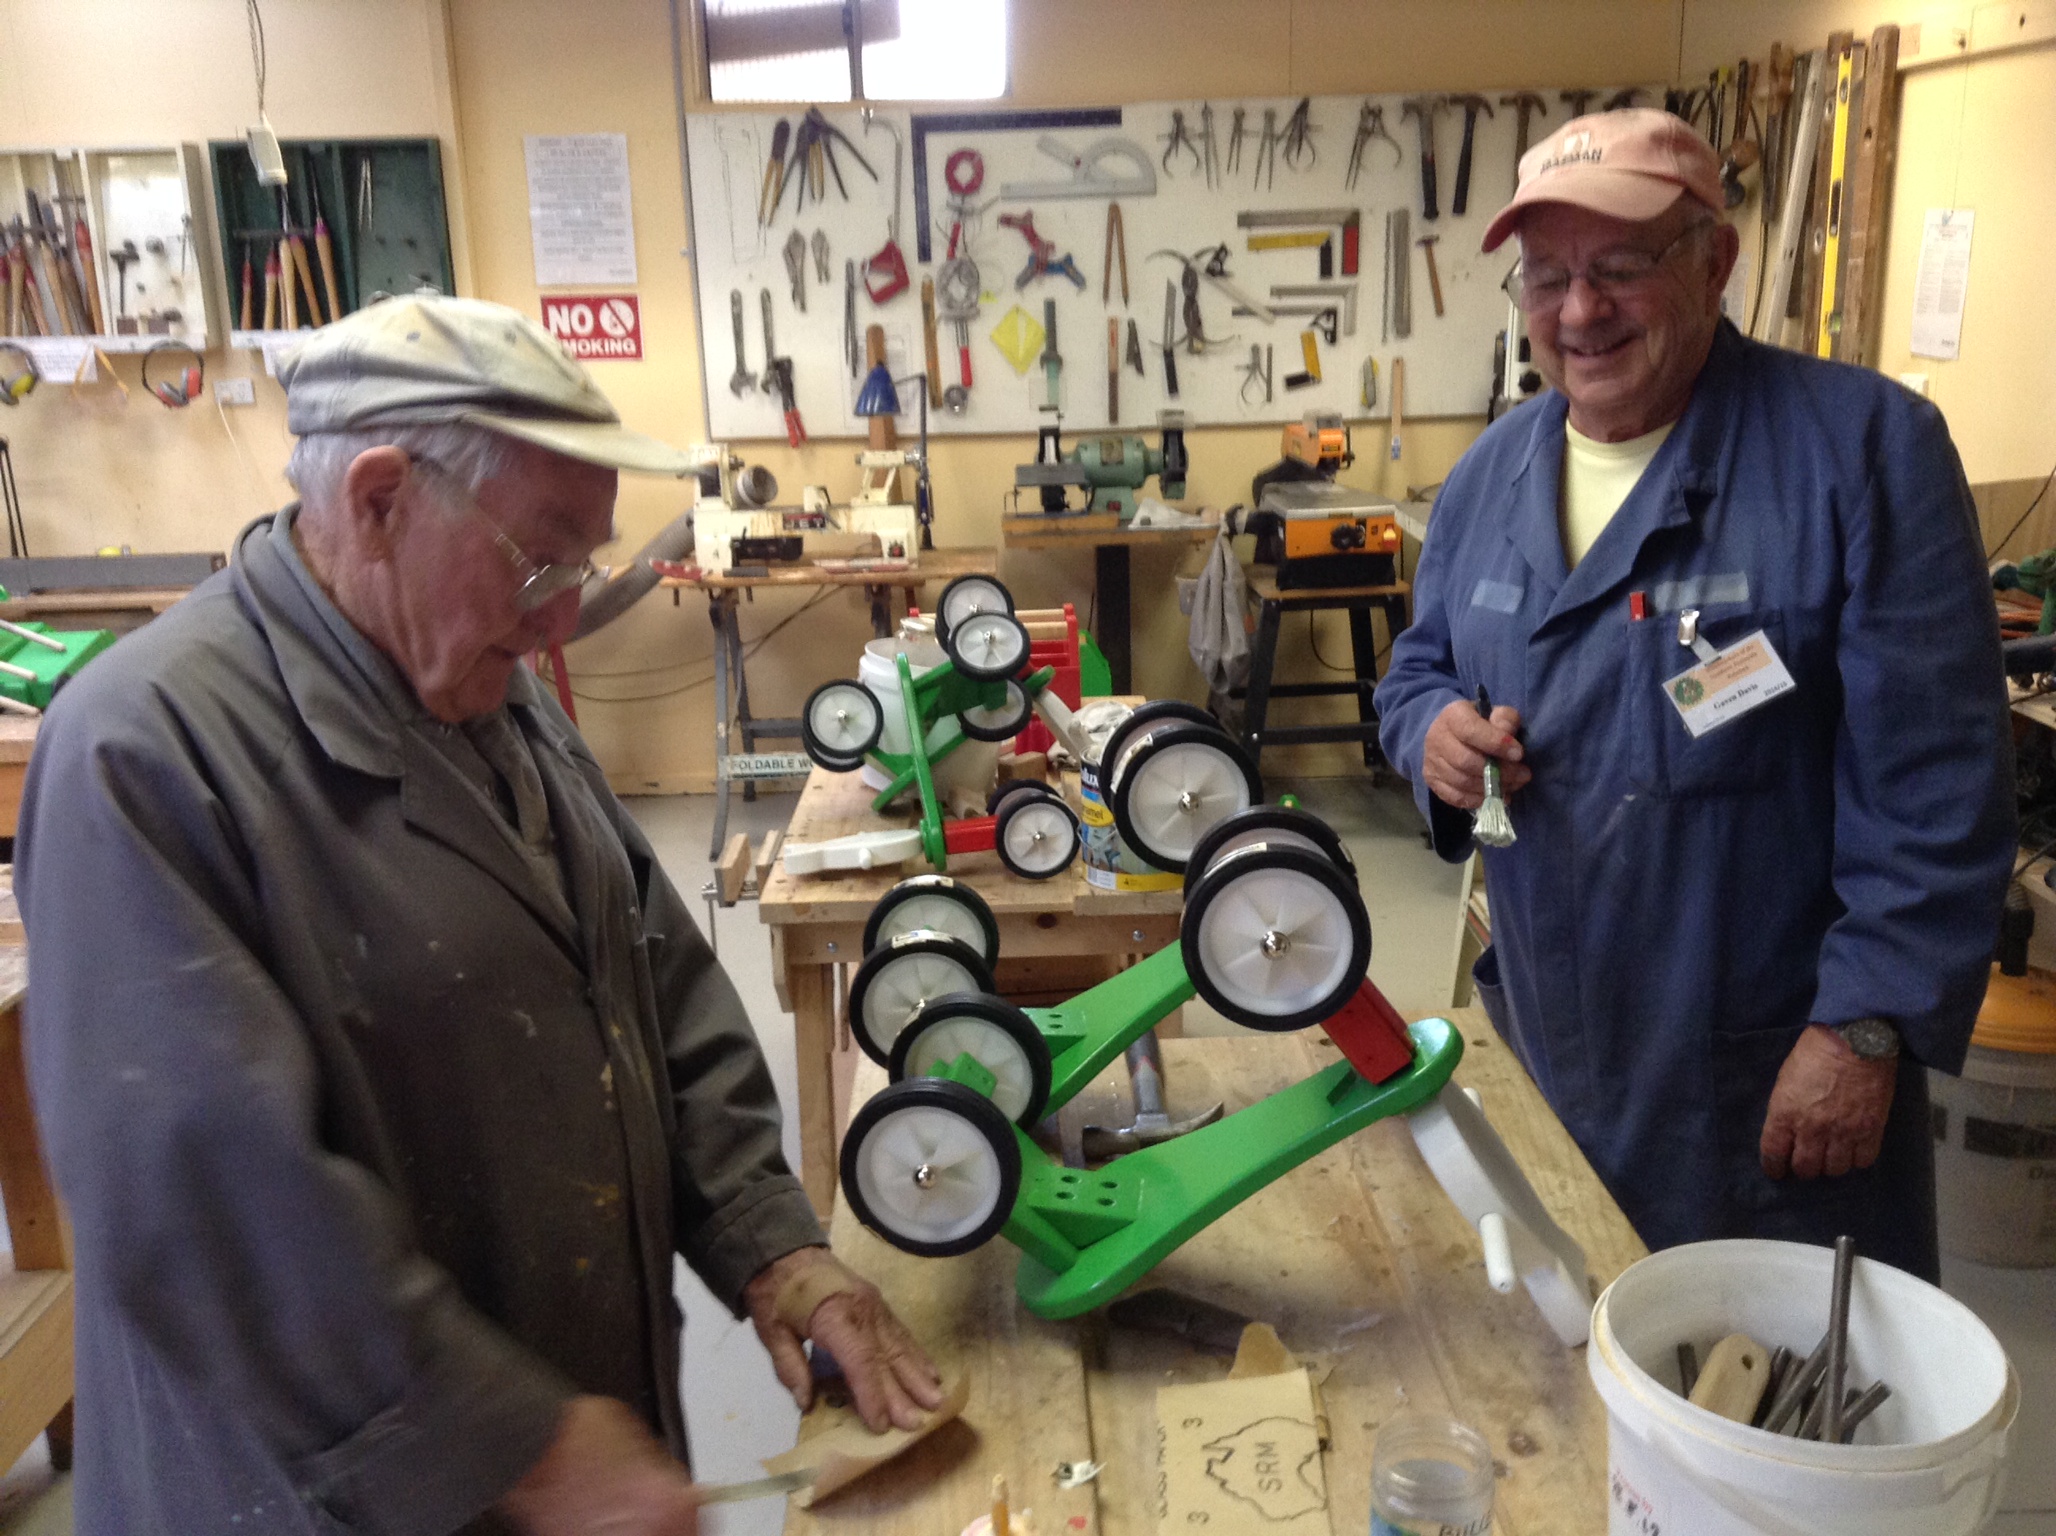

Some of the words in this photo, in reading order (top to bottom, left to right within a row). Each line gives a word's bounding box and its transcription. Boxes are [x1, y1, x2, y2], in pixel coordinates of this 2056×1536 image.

[547, 303, 594, 337] NO
[562, 337, 637, 357] MOKING
[731, 758, 795, 771] FOLDABLE
